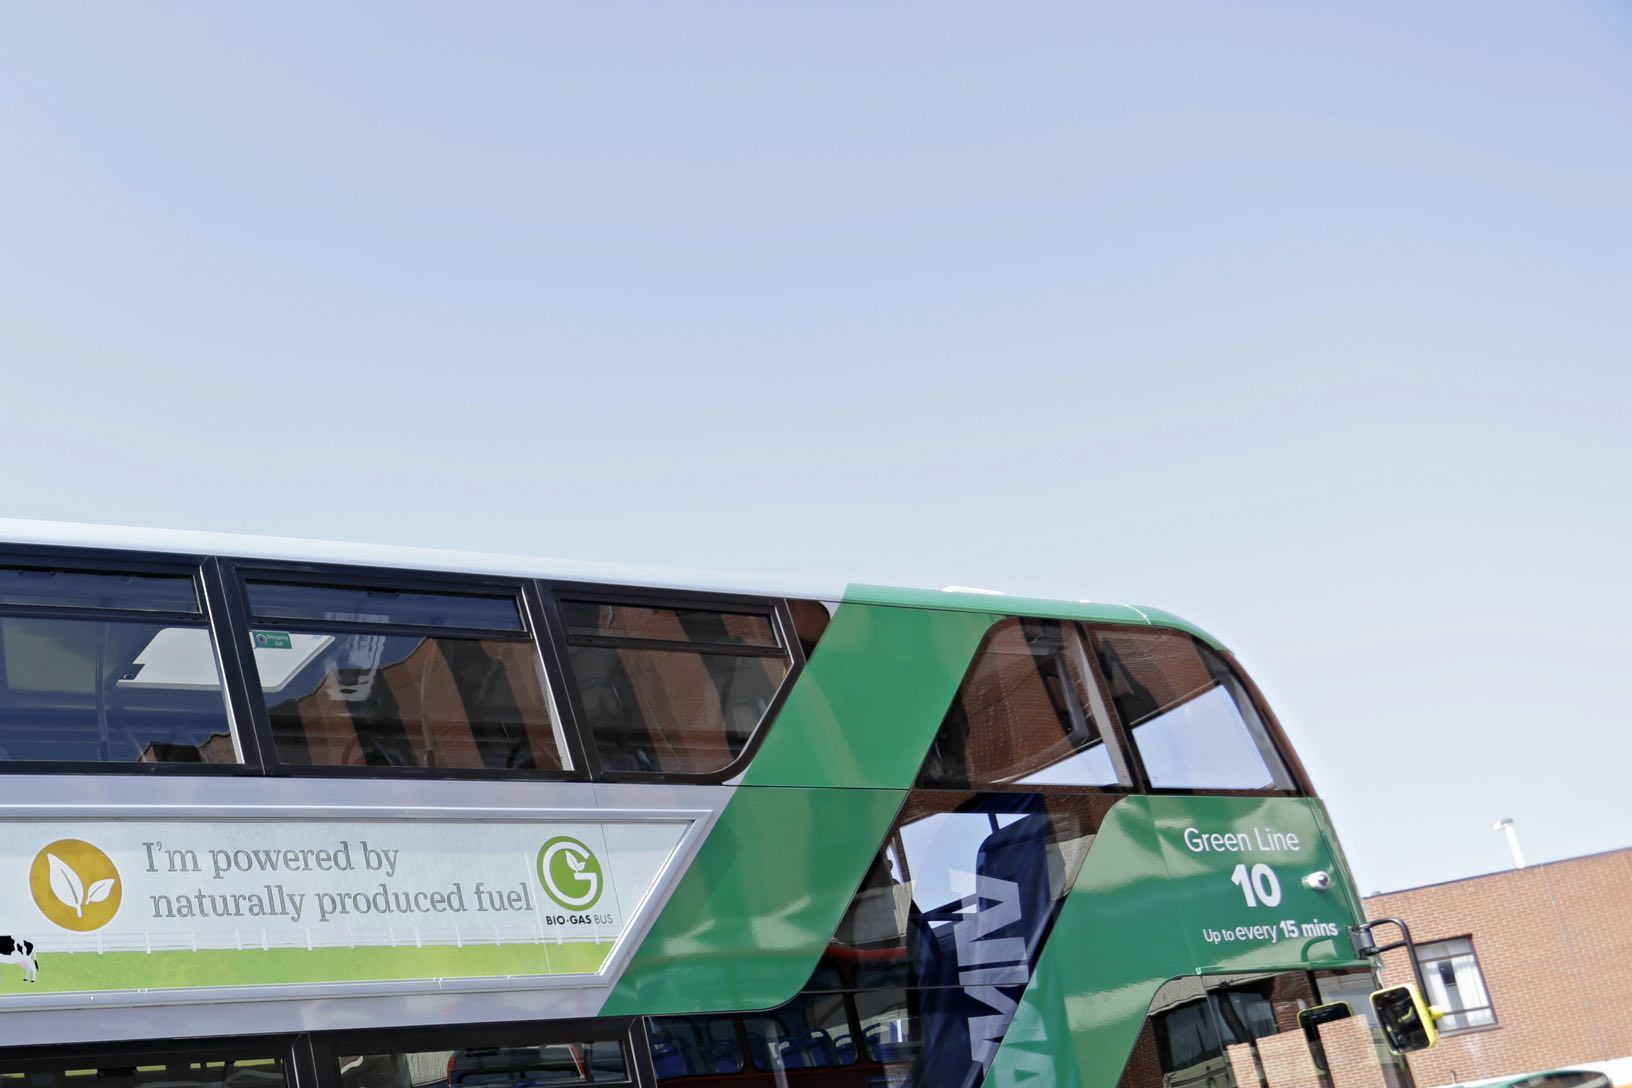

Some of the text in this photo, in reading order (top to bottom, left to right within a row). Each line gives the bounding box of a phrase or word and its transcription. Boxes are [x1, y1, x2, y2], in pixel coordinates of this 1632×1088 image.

[1183, 827, 1301, 852] Green Line
[141, 840, 400, 880] I'm powered by
[1230, 862, 1283, 908] 10
[151, 881, 534, 923] naturally produced fuel
[545, 913, 614, 926] BIO-GAS BUS
[1202, 918, 1339, 945] Up to every 15 mins
